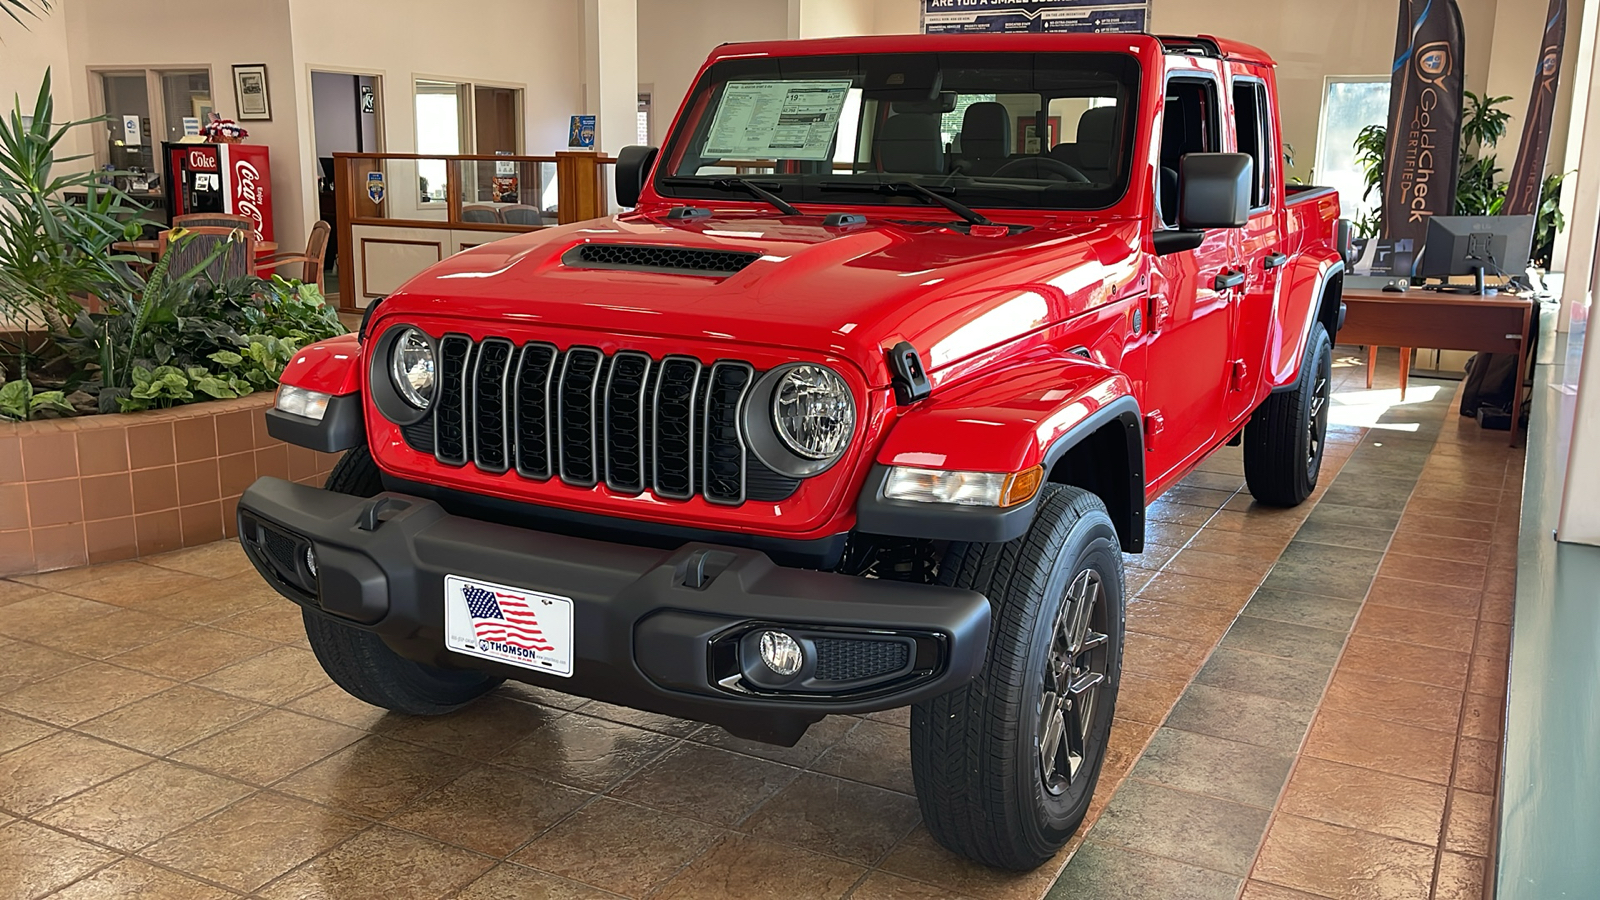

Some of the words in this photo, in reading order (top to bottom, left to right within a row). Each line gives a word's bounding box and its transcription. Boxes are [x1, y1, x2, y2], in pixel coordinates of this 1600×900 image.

[190, 150, 216, 168] Coke
[1400, 119, 1421, 191] CERTIFIED
[1408, 87, 1438, 223] GoldCheck
[490, 641, 536, 659] THOMSON
